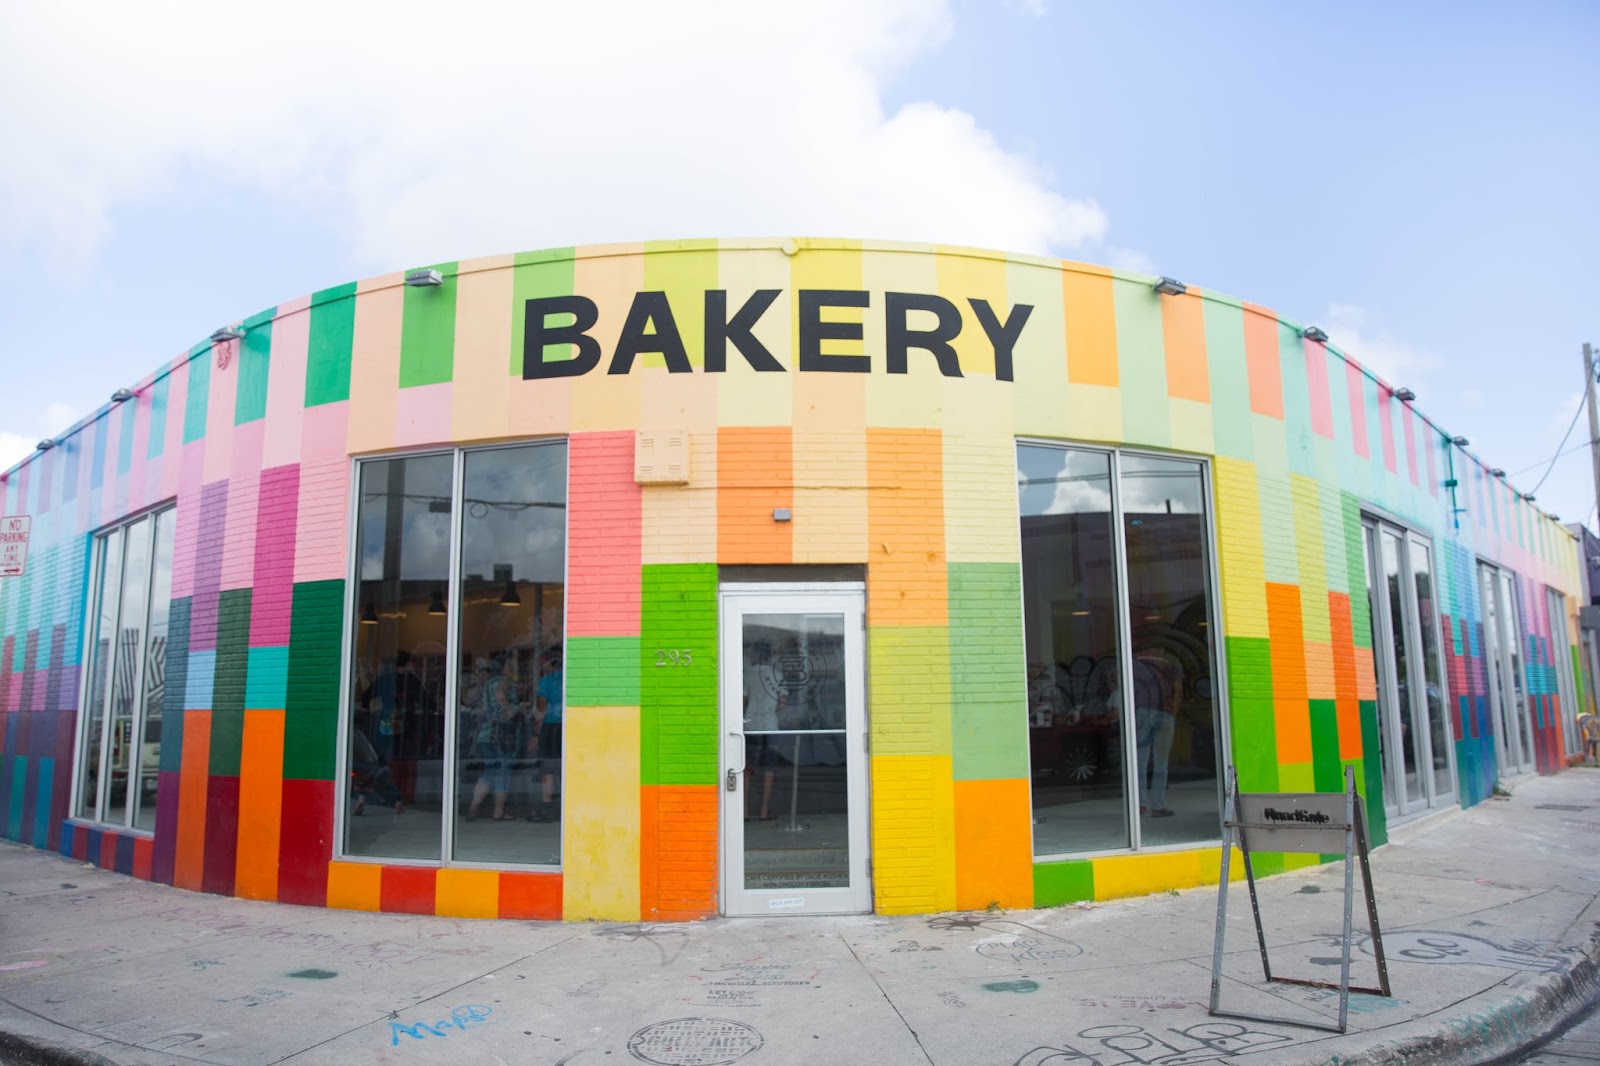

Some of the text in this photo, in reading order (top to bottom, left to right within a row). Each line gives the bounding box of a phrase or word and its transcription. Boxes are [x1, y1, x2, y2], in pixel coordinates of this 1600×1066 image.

[523, 289, 1035, 382] BAKERY
[9, 519, 22, 531] NO
[655, 649, 692, 667] 295
